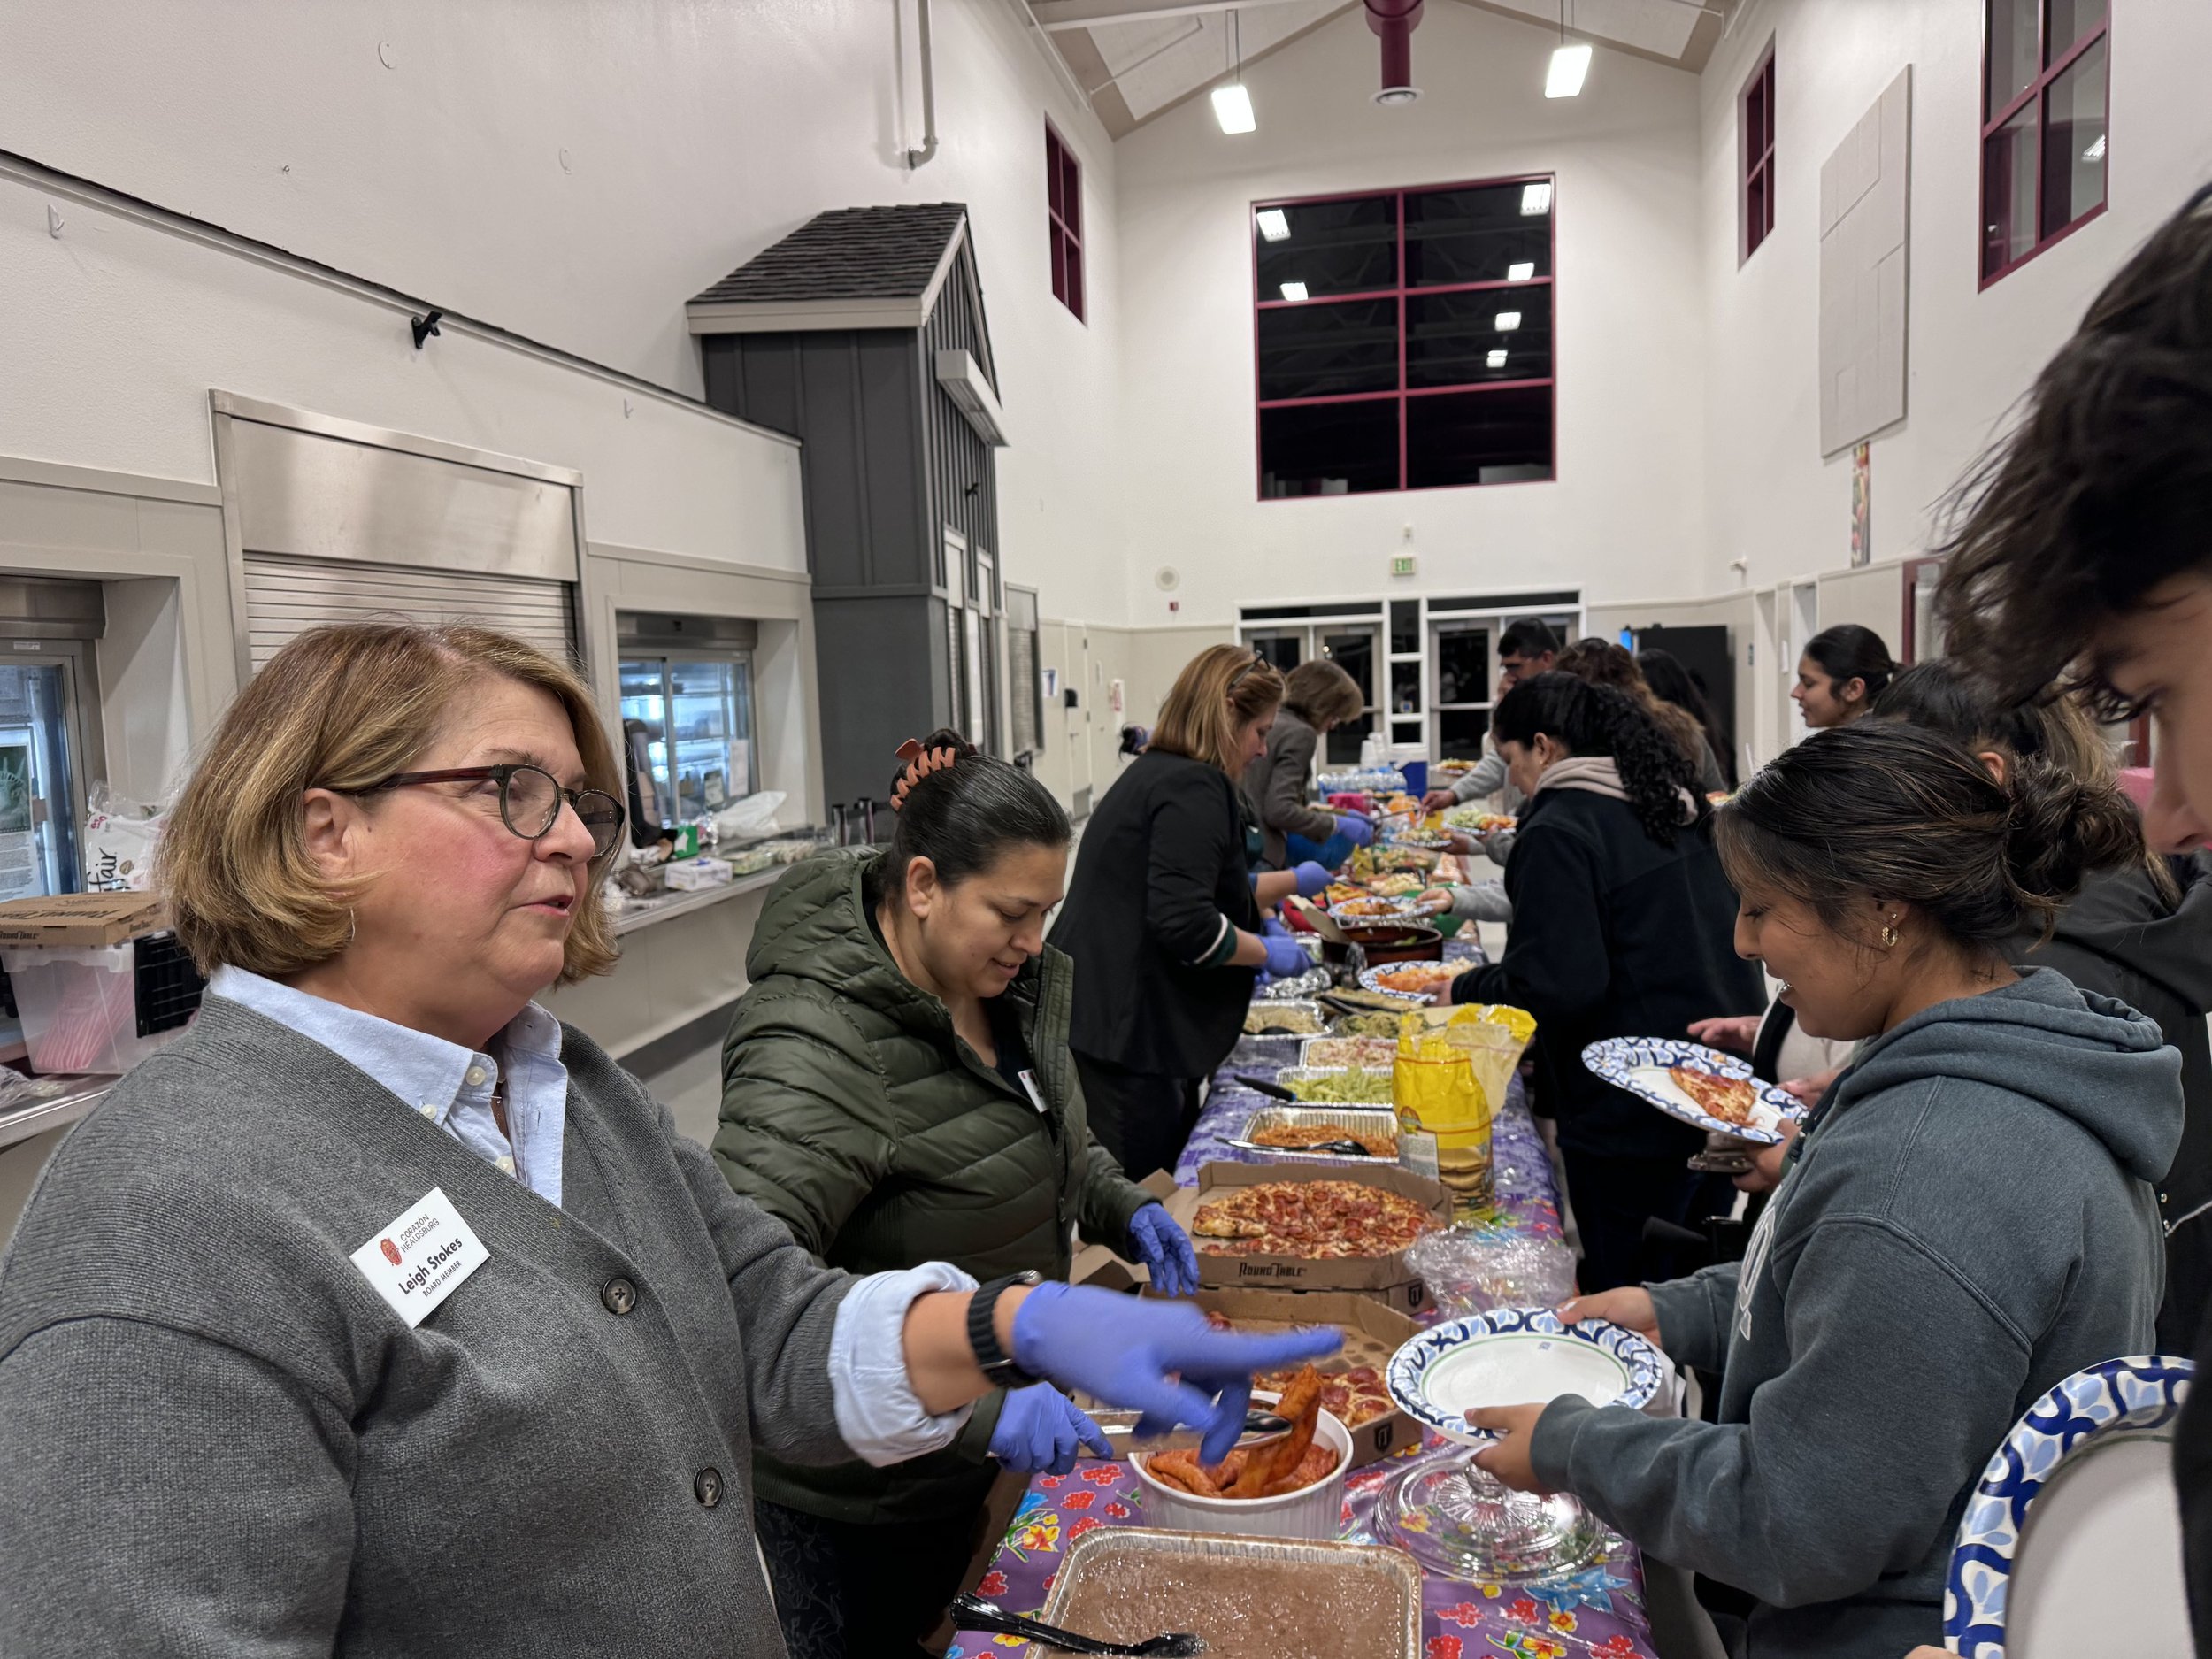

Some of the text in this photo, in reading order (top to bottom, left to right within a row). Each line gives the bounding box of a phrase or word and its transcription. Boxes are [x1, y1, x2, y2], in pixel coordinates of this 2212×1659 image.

[400, 1213, 430, 1242] CORAZÓN
[401, 1217, 441, 1253] HEALDSBURG
[397, 1237, 463, 1295] Leigh Stokes
[422, 1260, 462, 1297] BOARD MEMBER
[1239, 1262, 1302, 1278] ROUND TABLE
